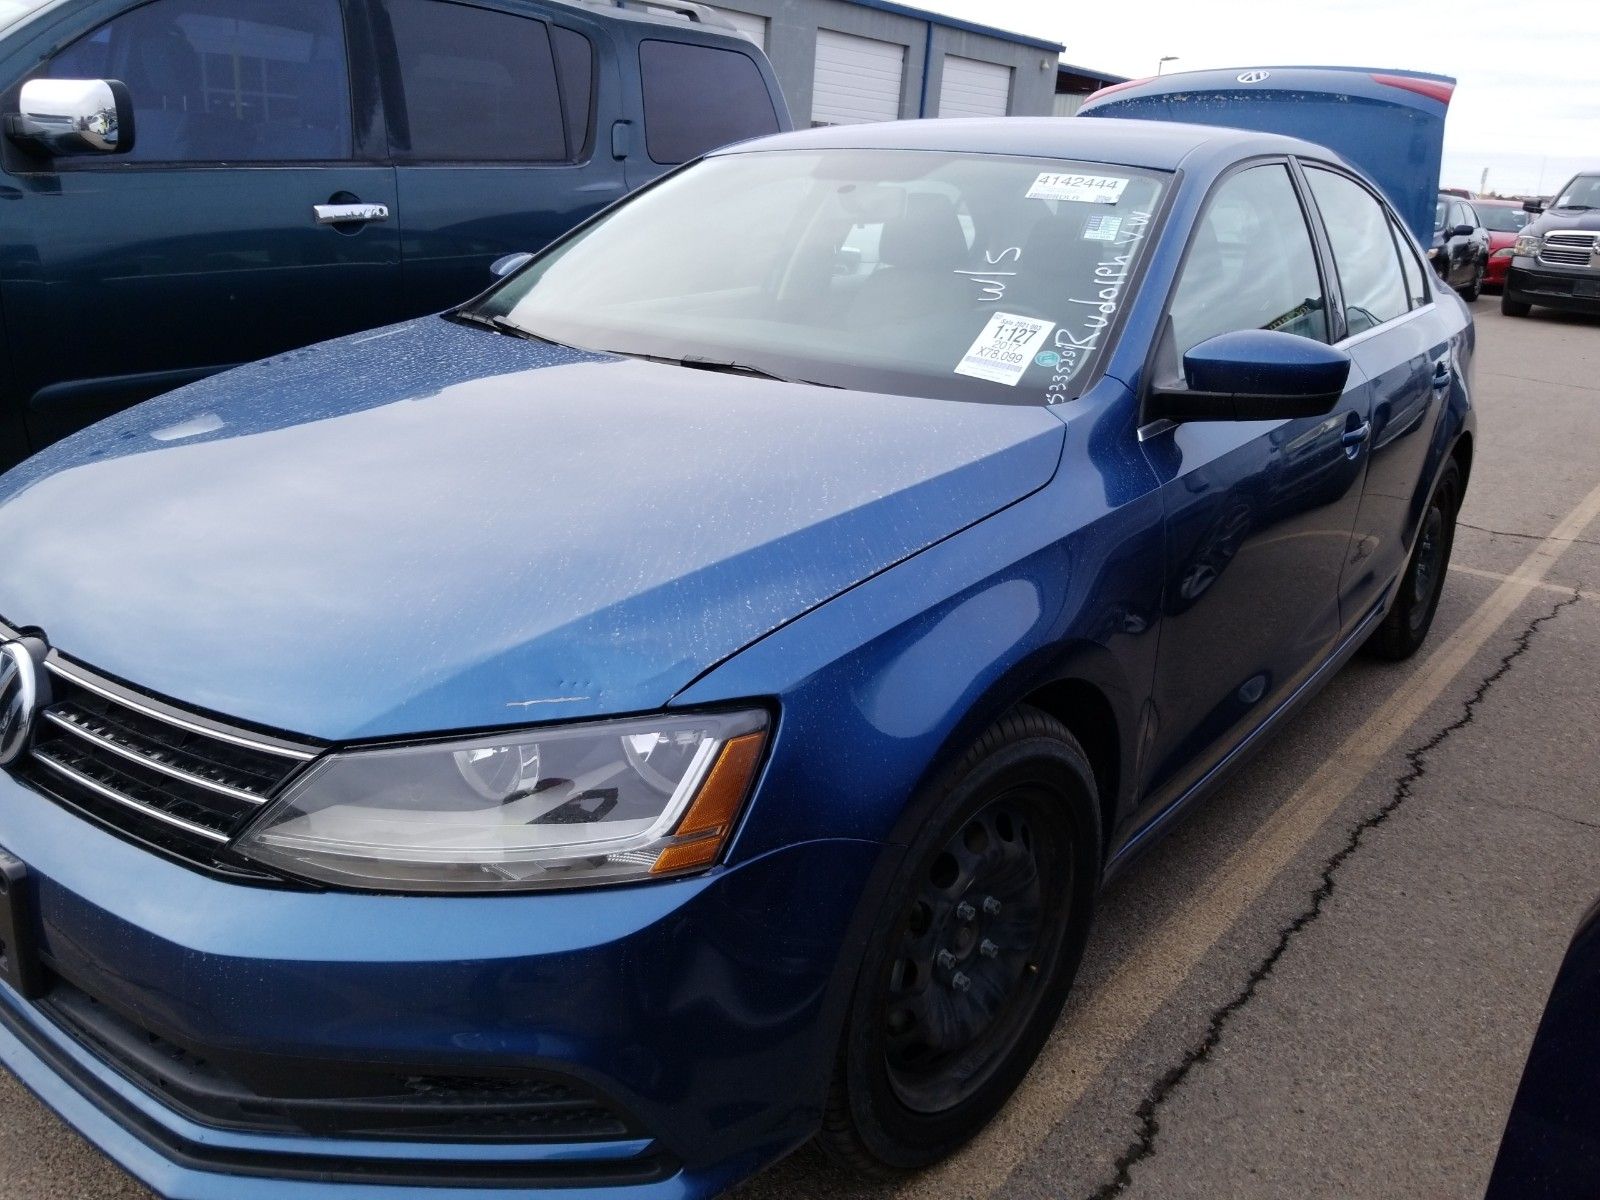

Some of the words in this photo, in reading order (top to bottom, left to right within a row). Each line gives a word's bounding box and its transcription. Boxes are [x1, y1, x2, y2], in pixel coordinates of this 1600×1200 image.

[1038, 175, 1118, 189] 4142444
[993, 325, 1037, 345] 1:127
[992, 340, 1022, 352] 2017
[976, 346, 1023, 364] X78.099
